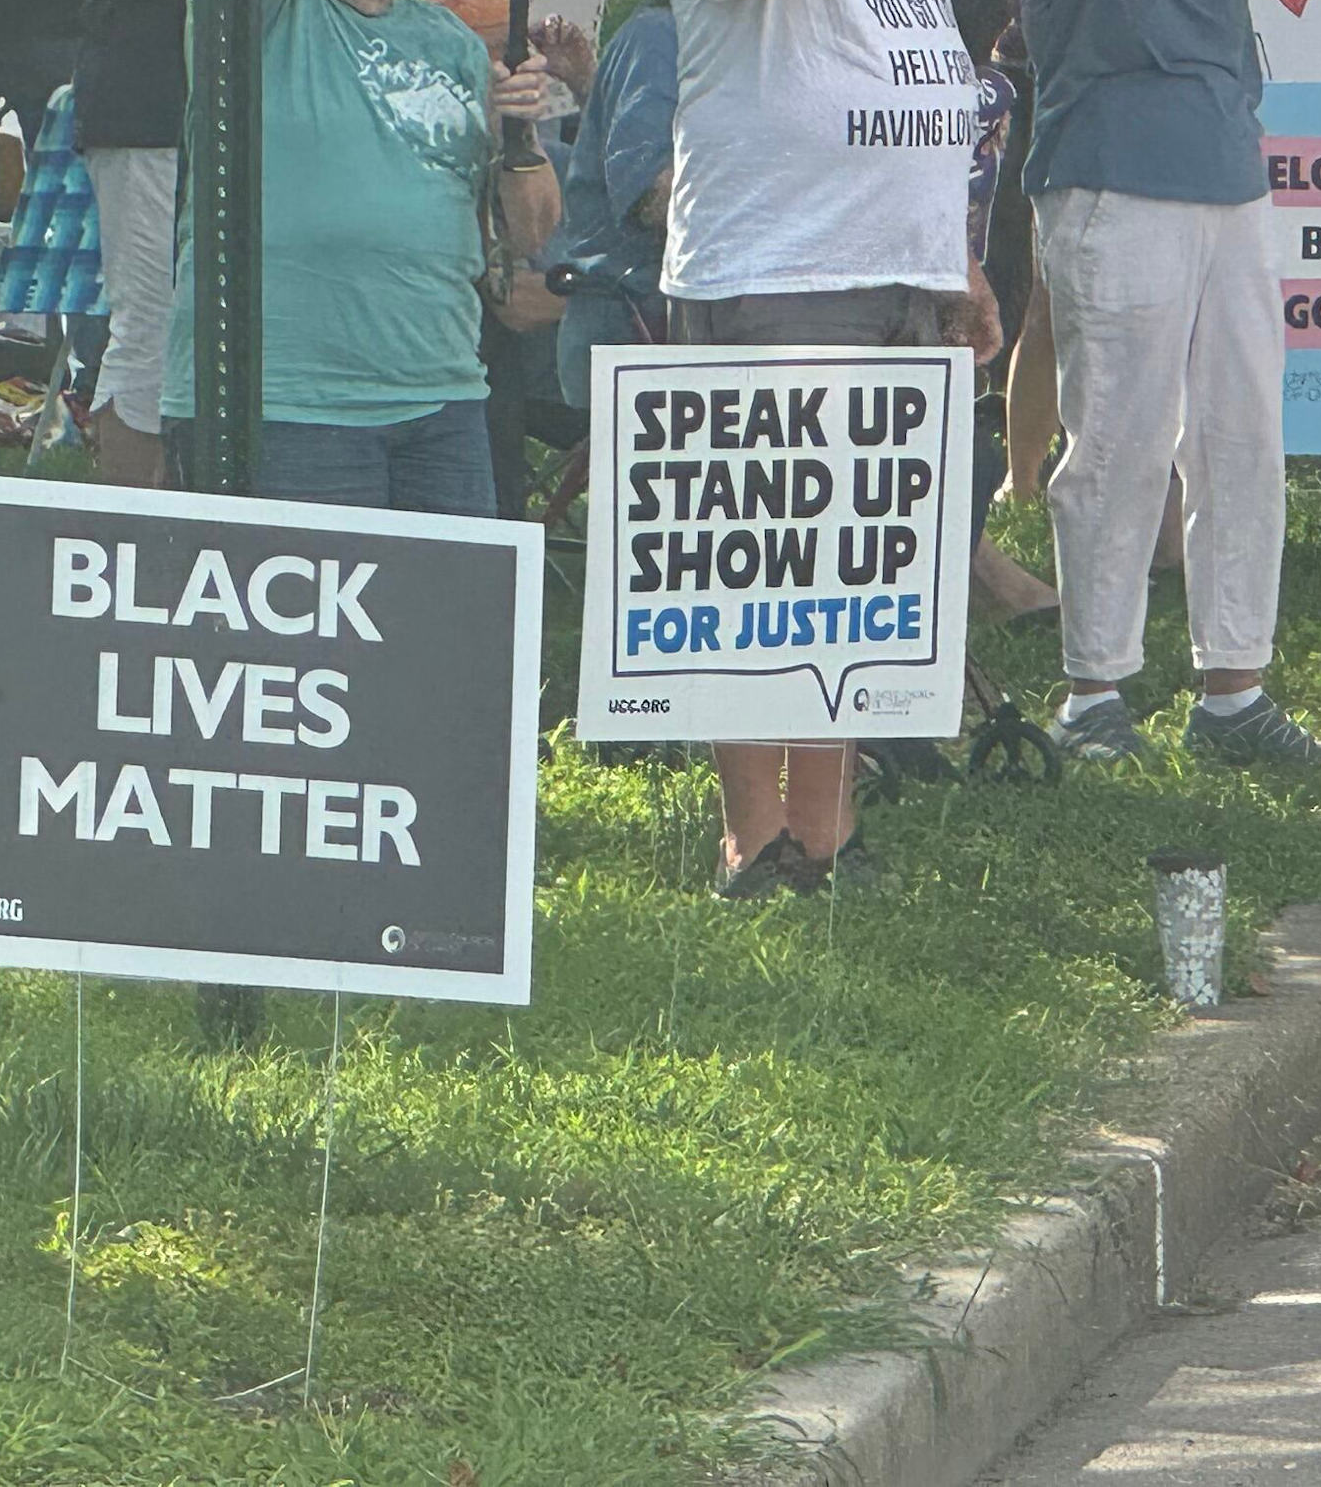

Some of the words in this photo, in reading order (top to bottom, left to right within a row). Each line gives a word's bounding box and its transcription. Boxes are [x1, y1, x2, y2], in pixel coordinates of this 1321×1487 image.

[888, 50, 946, 86] HELL
[847, 108, 942, 147] HAVING
[634, 387, 828, 451] SPEAK
[848, 386, 927, 447] UP
[628, 458, 833, 522] STAND
[853, 457, 932, 518] UP
[51, 537, 383, 642] BLACK
[630, 527, 818, 593] SHOW
[837, 525, 917, 586] UP
[626, 605, 720, 656] FOR
[735, 594, 921, 650] JUSTICE
[97, 652, 351, 749] LIVES
[608, 699, 670, 714] UCC.ORG
[19, 756, 421, 867] MATTER
